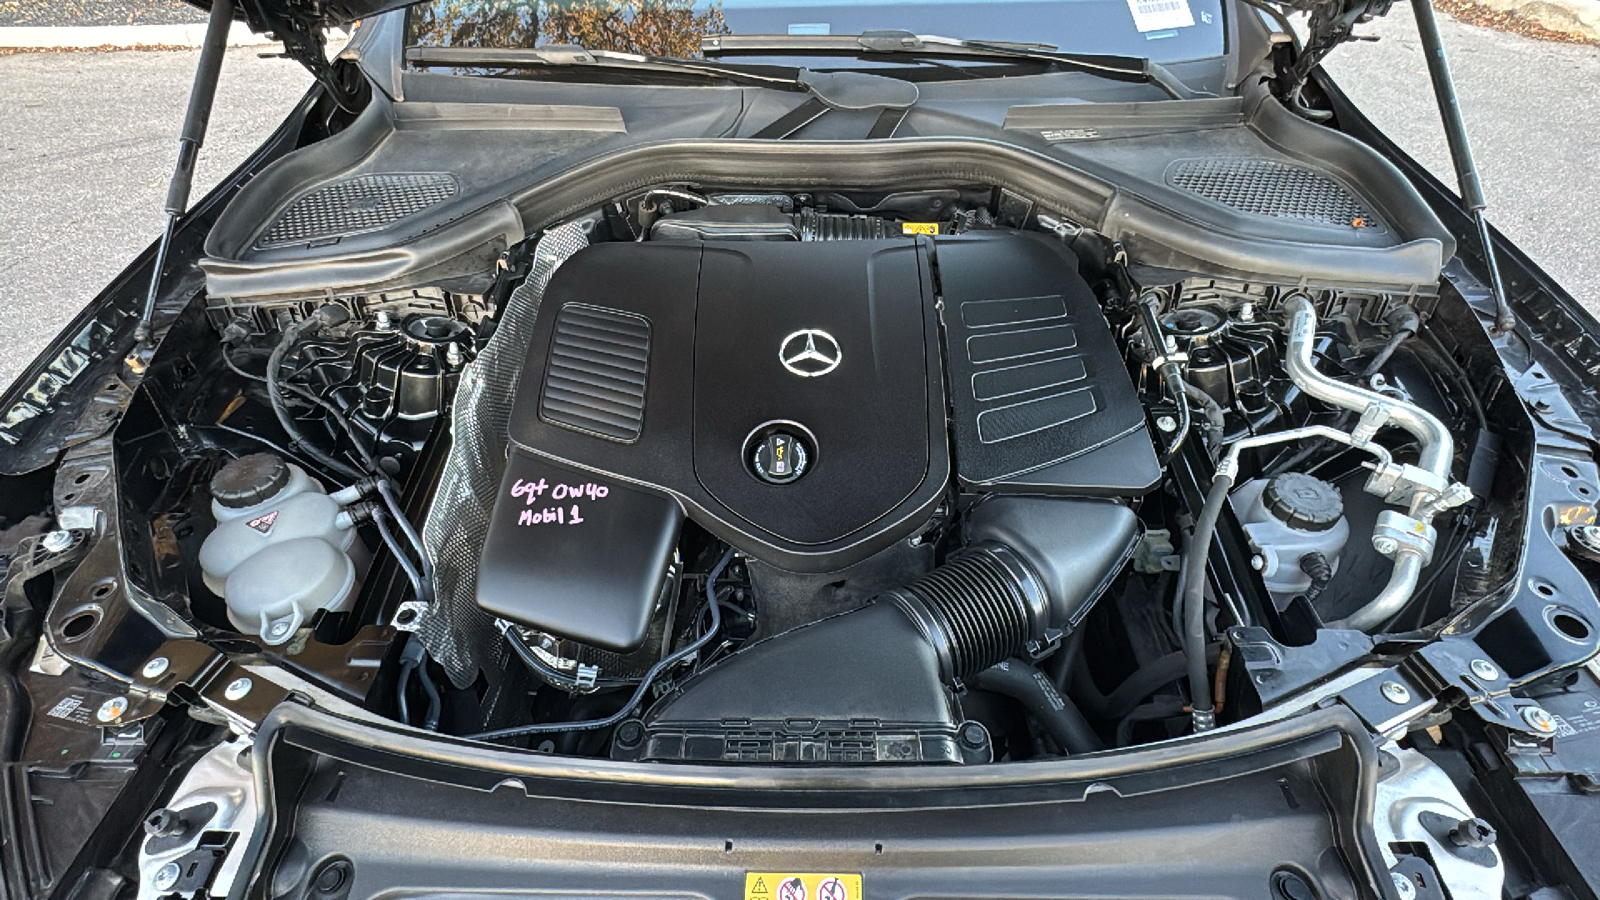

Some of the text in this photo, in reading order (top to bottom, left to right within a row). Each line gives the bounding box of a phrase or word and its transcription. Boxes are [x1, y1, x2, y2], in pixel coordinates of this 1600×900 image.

[510, 477, 549, 506] 6qt
[517, 504, 584, 527] Mobil 1
